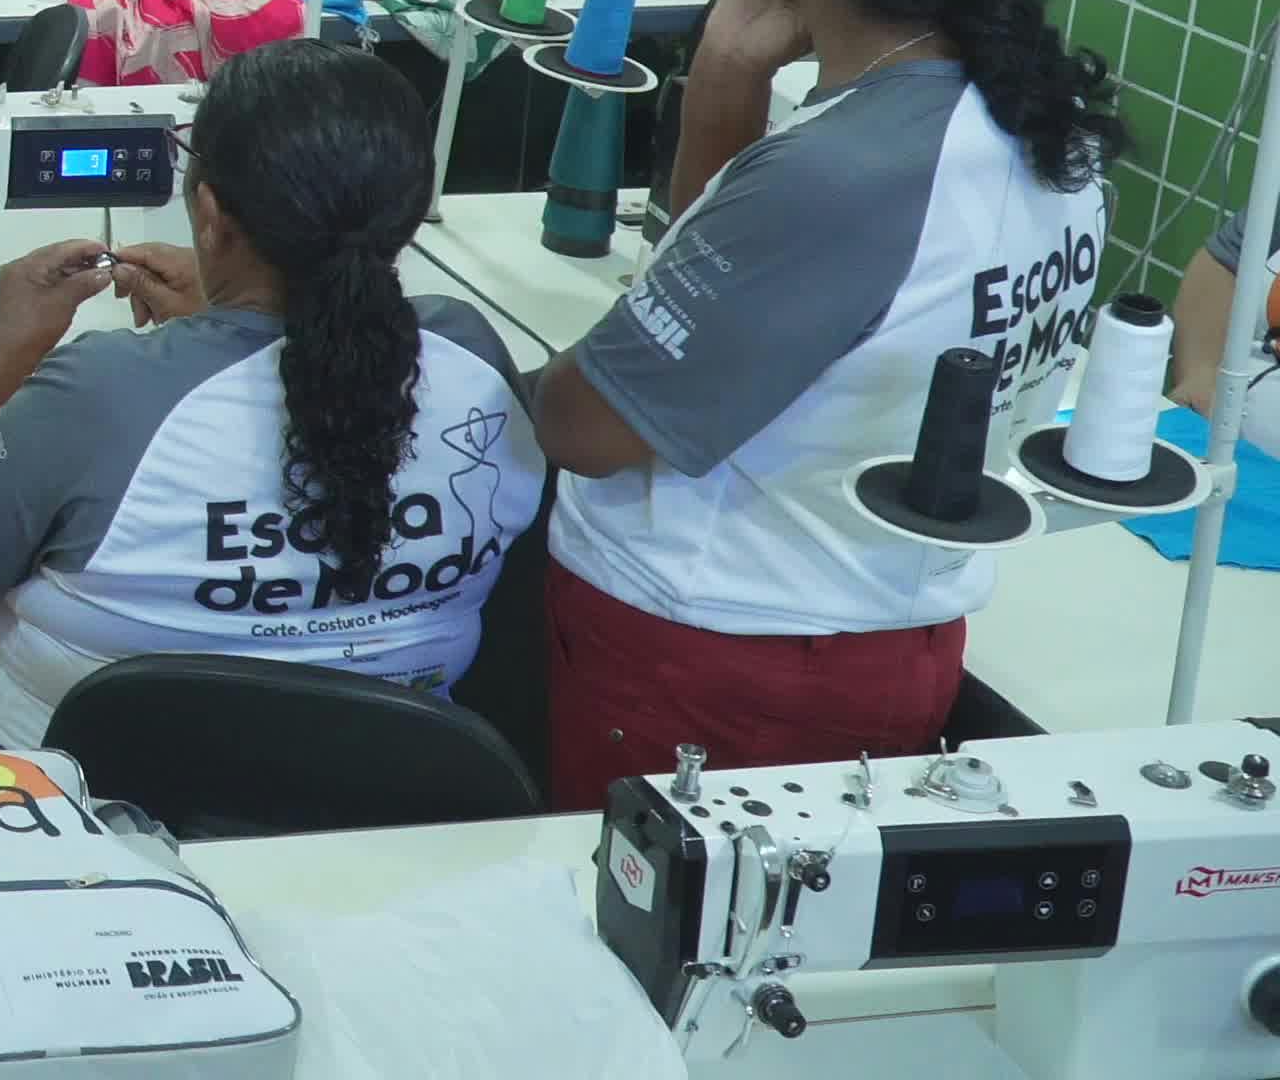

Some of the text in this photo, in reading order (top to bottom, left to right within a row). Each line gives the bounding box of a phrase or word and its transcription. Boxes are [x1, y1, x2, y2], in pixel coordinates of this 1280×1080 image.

[970, 225, 1097, 340] Escola
[206, 493, 443, 561] Esca
[194, 565, 303, 614] de
[251, 624, 304, 638] Corte,
[124, 957, 245, 989] BRASIL
